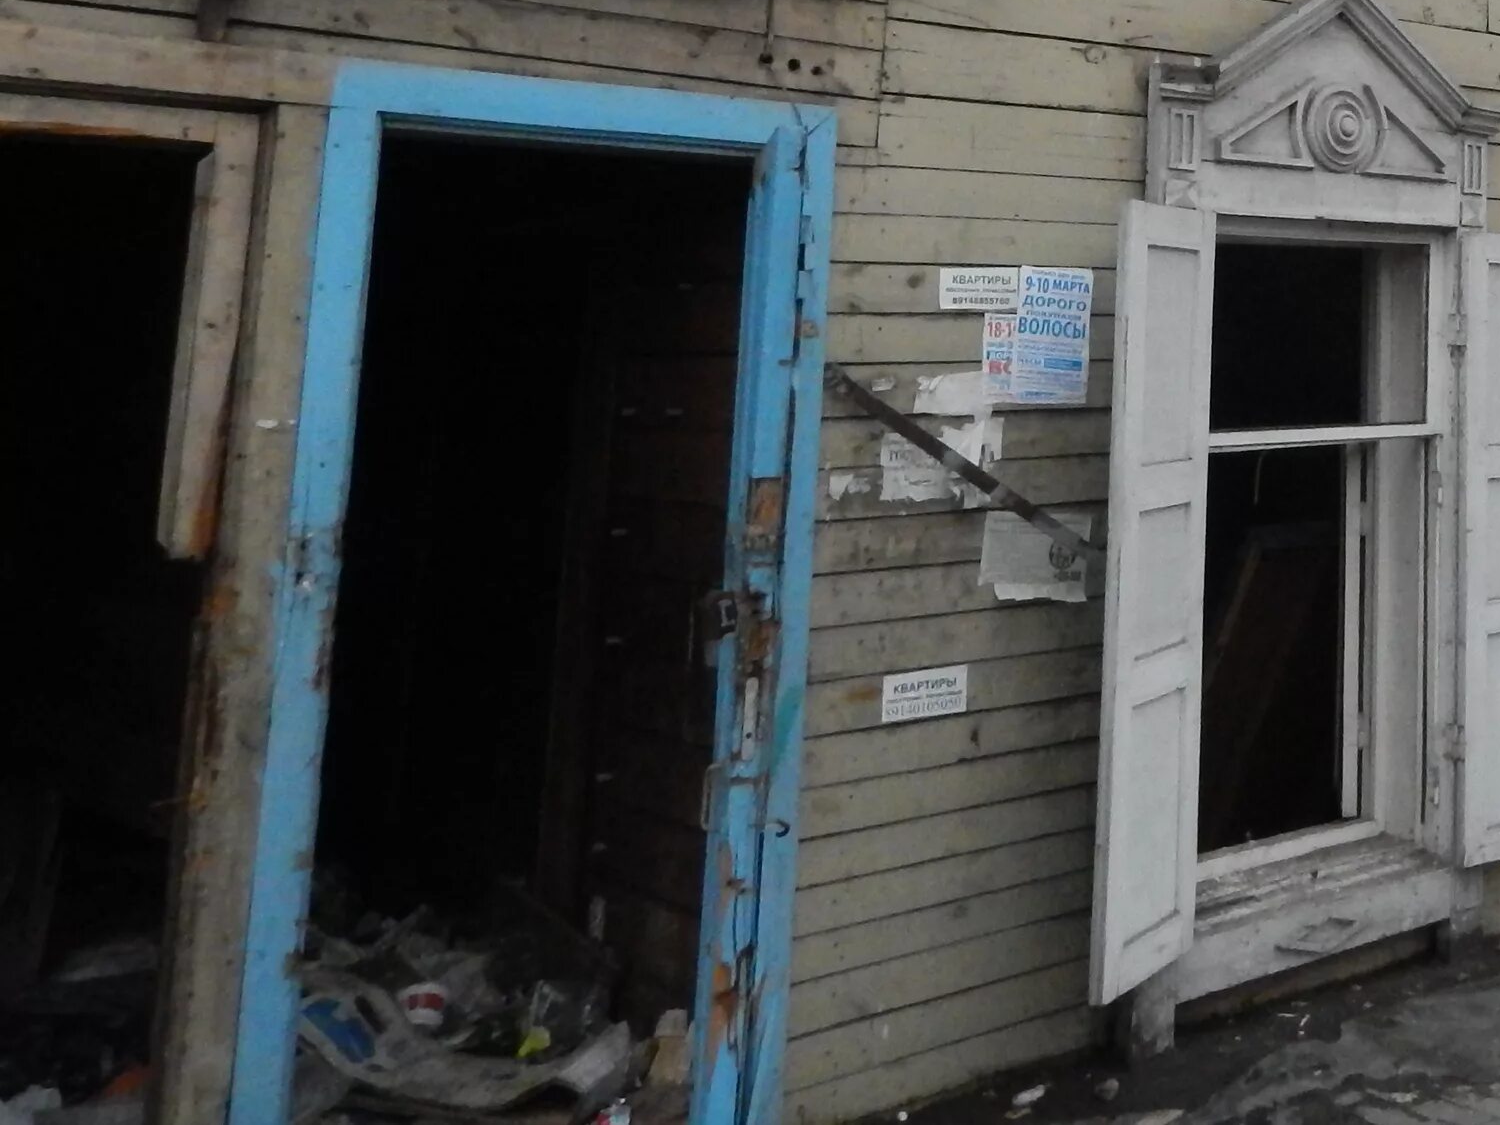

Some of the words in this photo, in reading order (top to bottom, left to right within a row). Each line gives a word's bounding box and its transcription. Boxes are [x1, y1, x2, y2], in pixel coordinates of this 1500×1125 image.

[952, 275, 1012, 285] КВАРТИРЫ
[1025, 276, 1049, 294] 9-10
[1052, 278, 1090, 294] МАРТА
[1022, 294, 1087, 312] ДОРОГО
[1018, 316, 1087, 340] ВОЛОСЫ
[893, 677, 957, 694] КВАРТИРЫ
